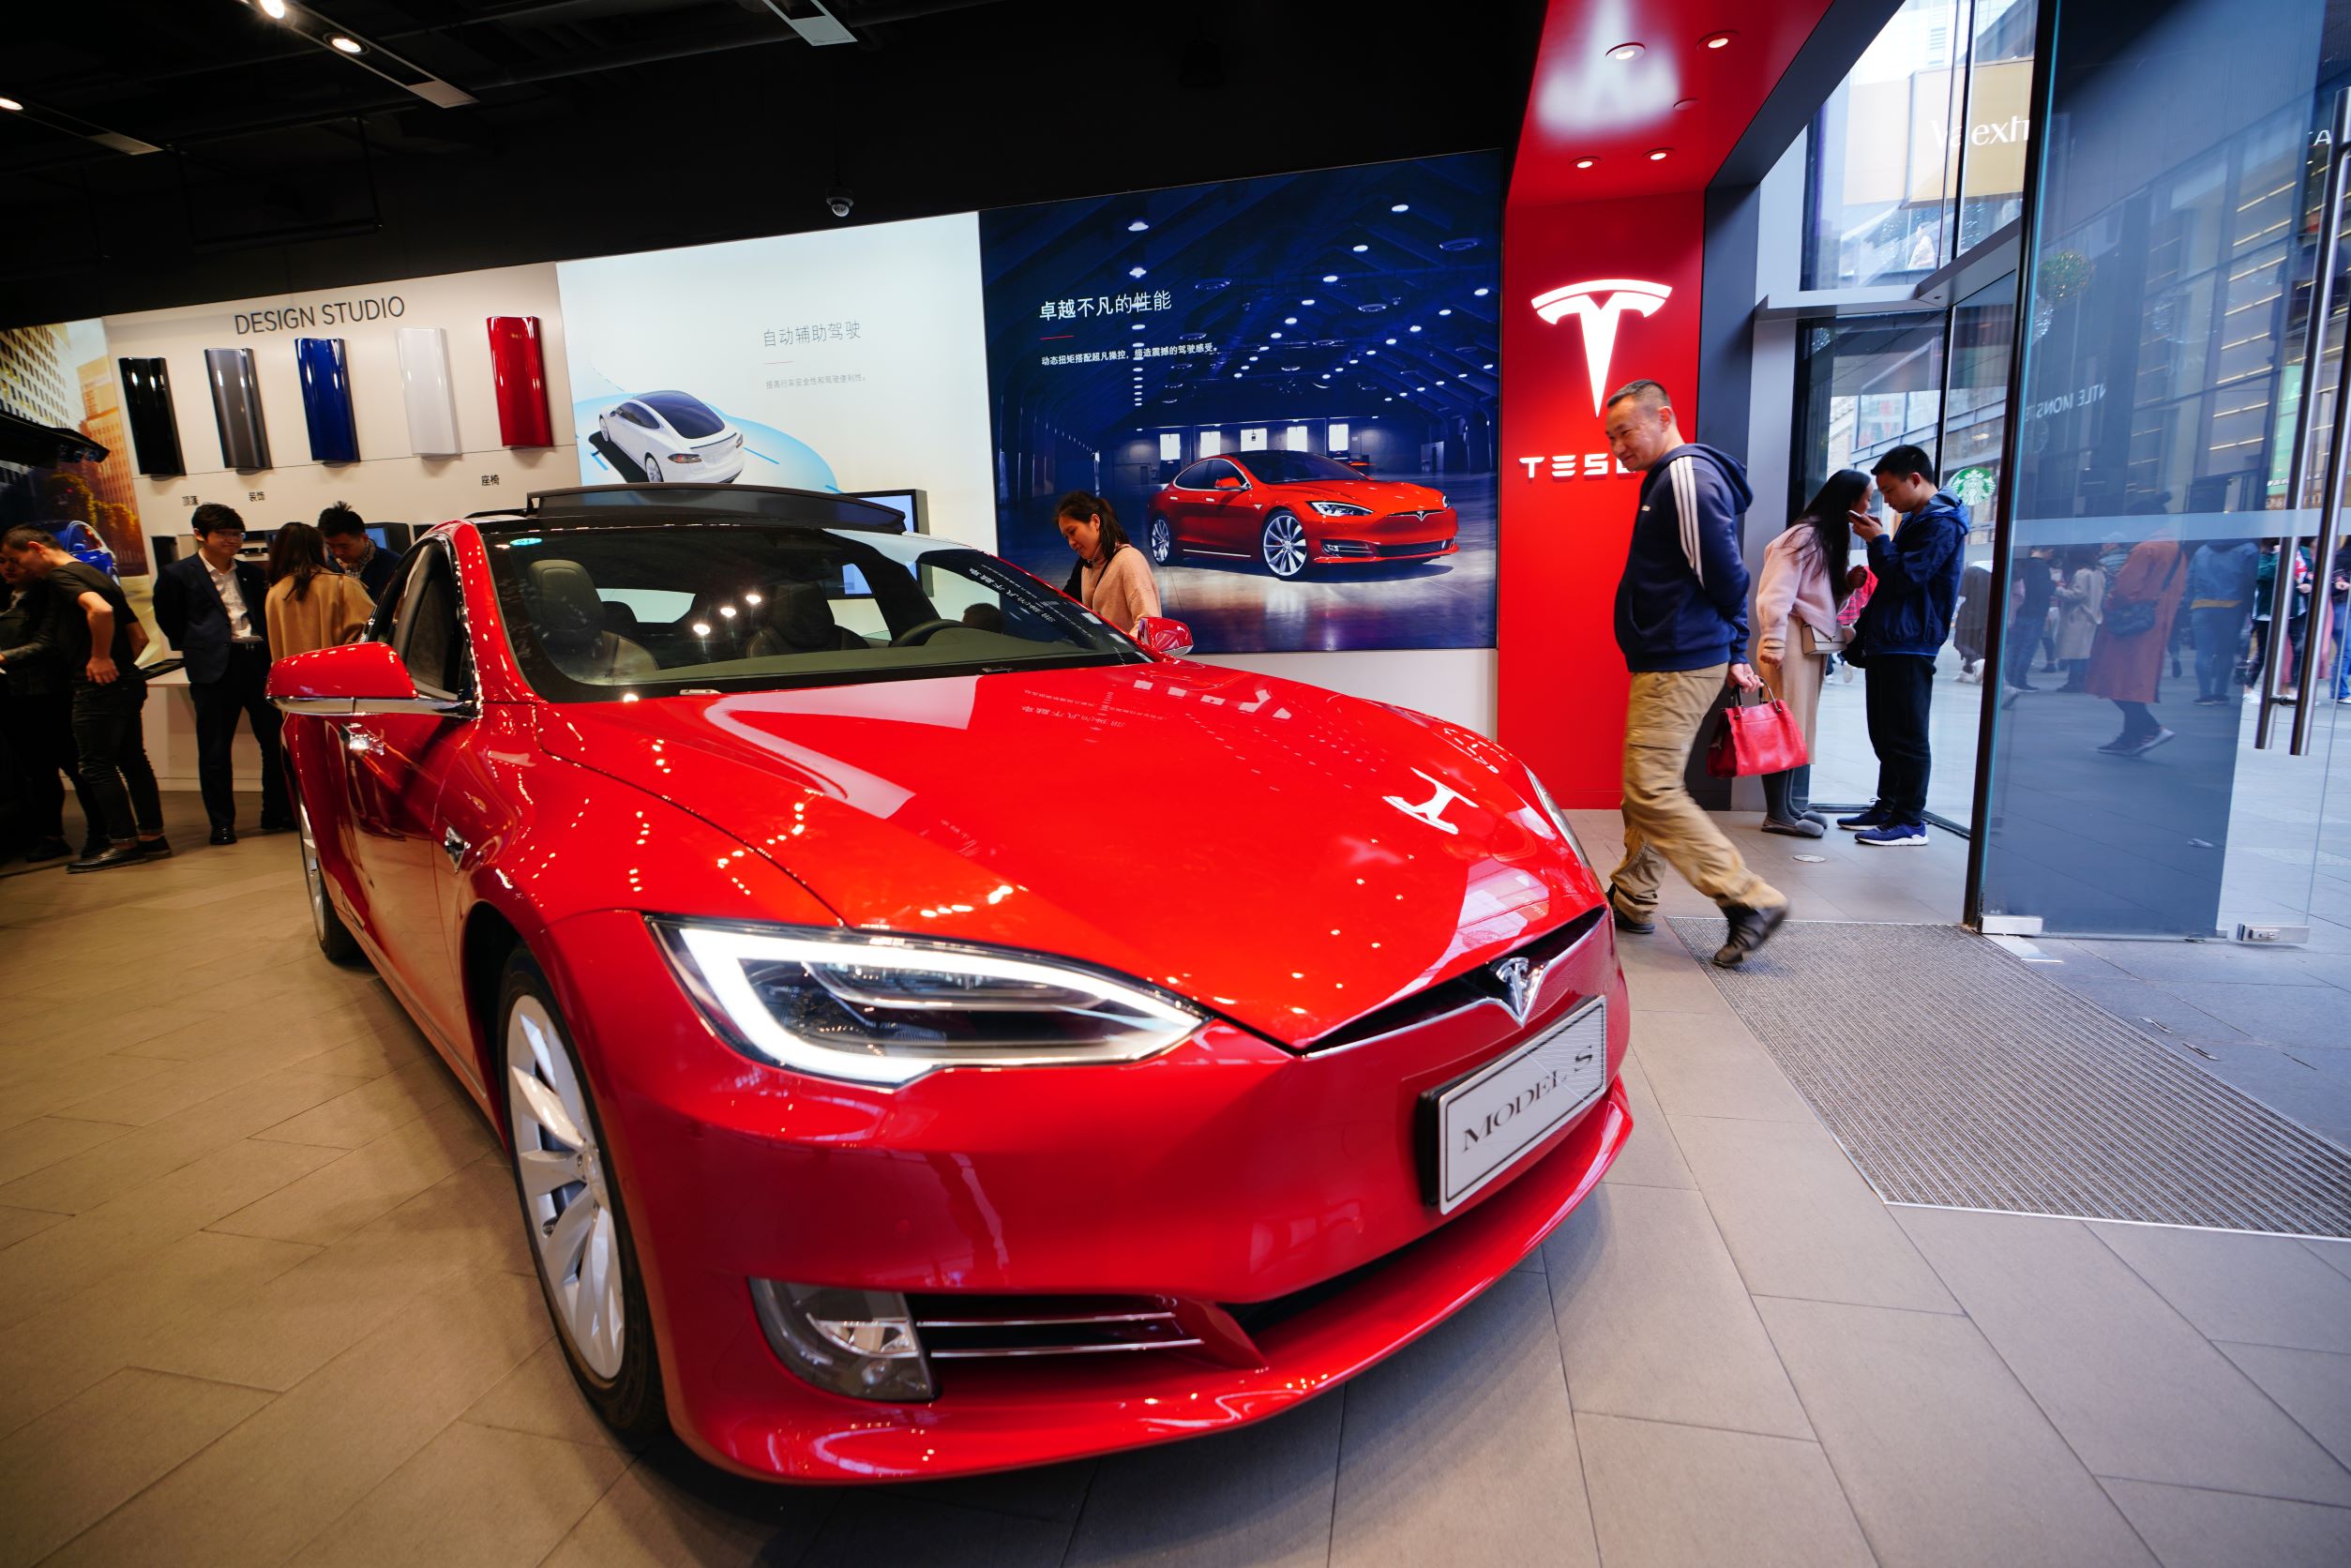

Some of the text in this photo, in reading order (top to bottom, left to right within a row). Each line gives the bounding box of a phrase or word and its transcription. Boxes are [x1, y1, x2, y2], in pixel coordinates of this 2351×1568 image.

[234, 295, 405, 335] DESIGN STUDIO
[1039, 290, 1172, 321] 卓越不凡的性能
[763, 320, 861, 347] 自动辅助驾驶
[1462, 1044, 1593, 1153] MODEL S
